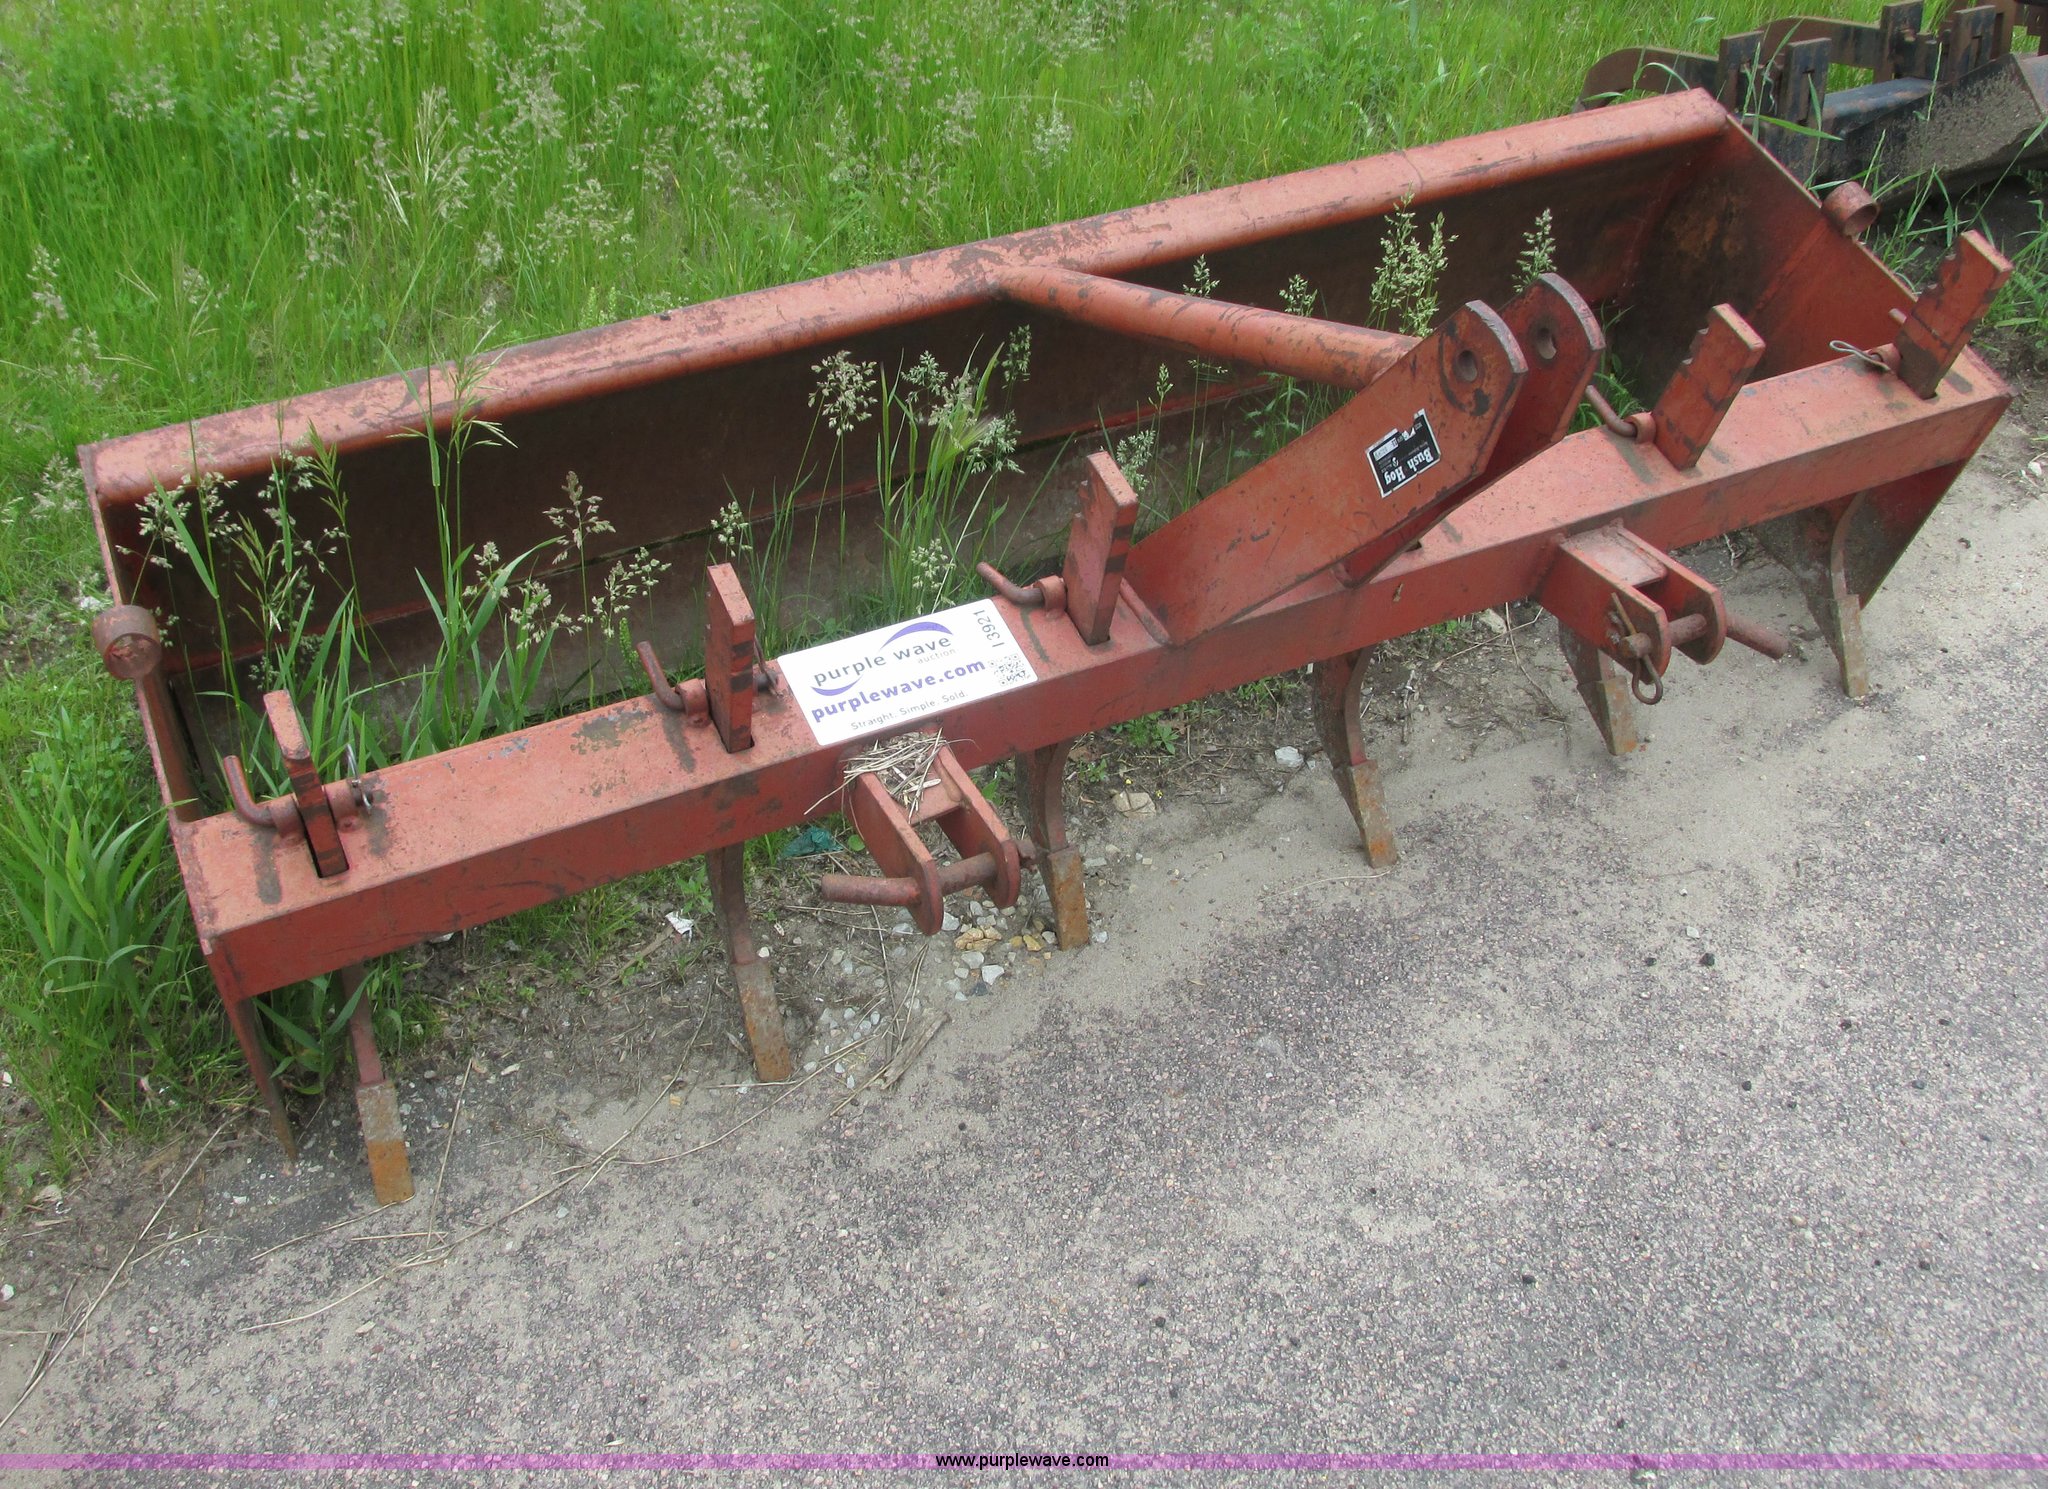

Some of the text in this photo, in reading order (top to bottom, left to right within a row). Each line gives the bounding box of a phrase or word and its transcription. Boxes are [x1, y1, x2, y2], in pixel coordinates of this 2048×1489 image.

[1384, 466, 1406, 485] Hog
[1407, 447, 1434, 472] Bush
[814, 637, 952, 687] purple wave
[917, 649, 956, 664] auction
[811, 659, 986, 722] purplewave.com
[851, 690, 968, 730] Straight. Simple. Sold.
